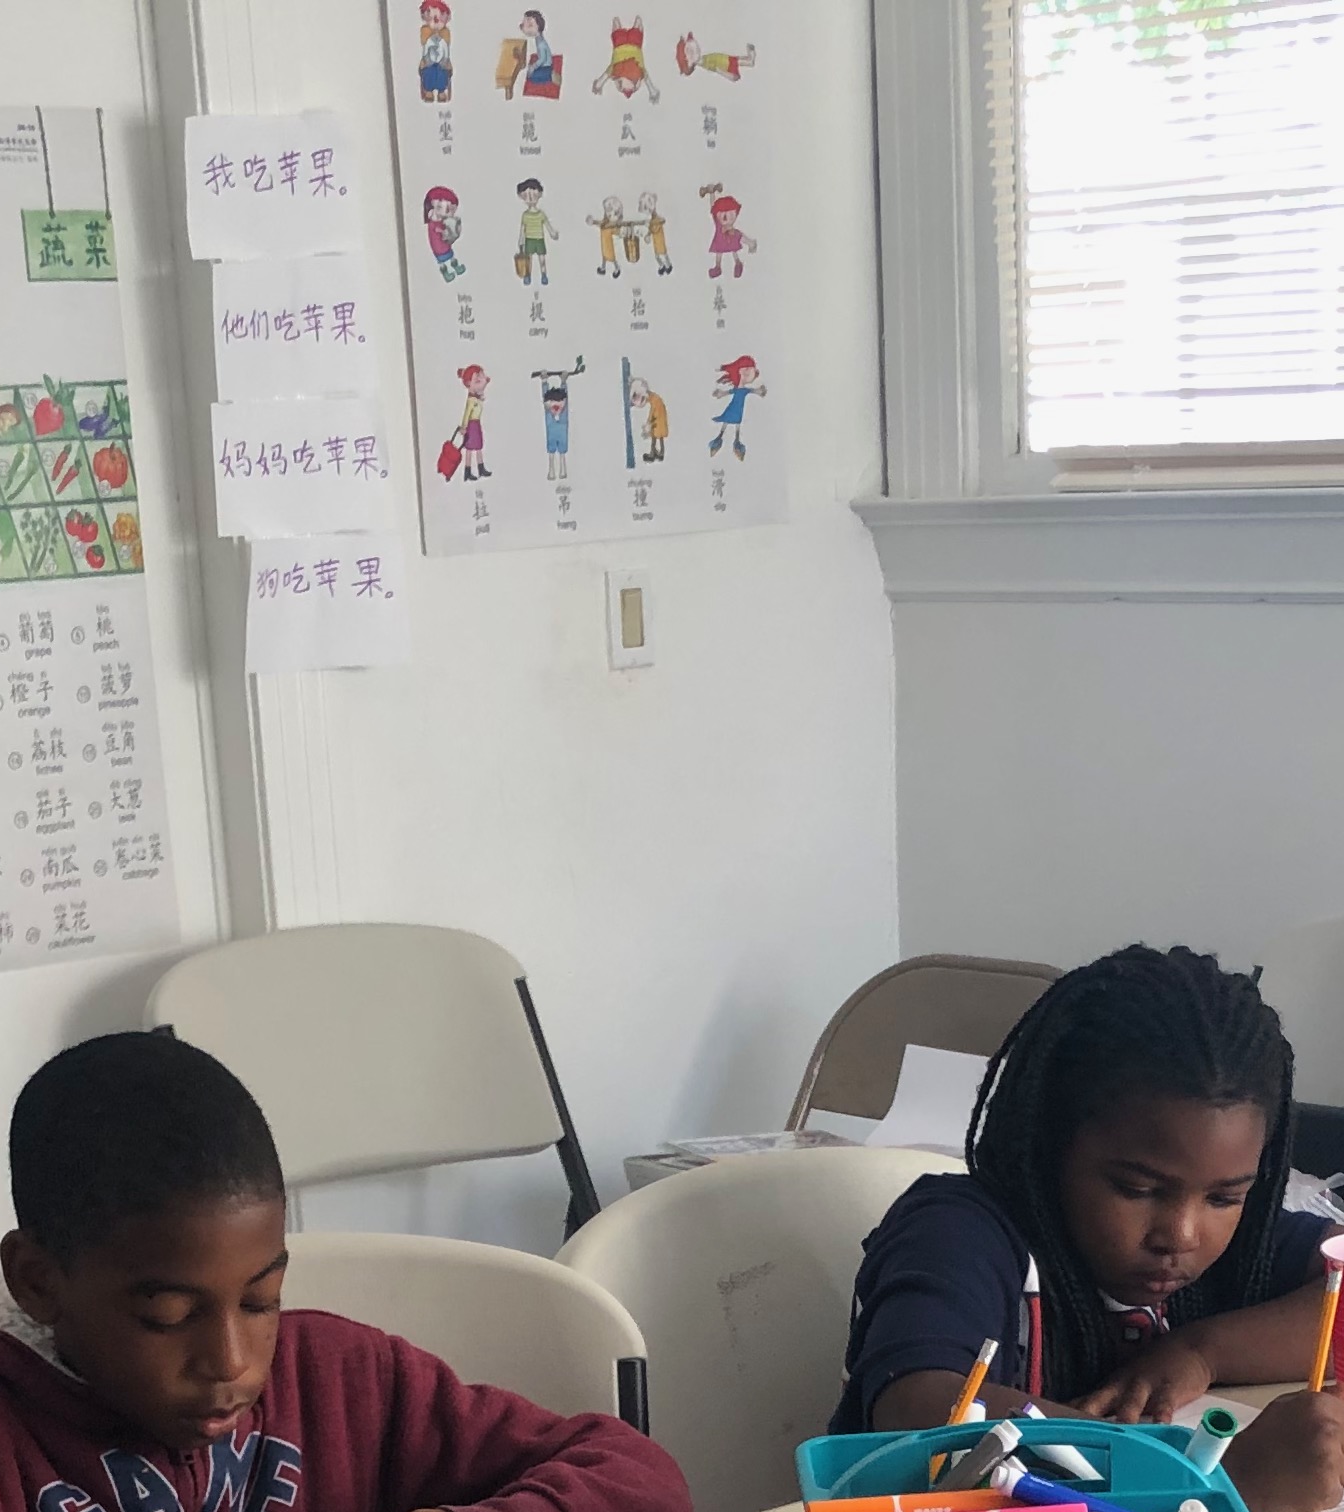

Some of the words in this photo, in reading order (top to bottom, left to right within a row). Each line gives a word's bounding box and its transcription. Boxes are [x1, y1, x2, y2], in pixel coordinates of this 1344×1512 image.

[203, 147, 347, 198] 我吃苹果。
[38, 220, 111, 269] 蔬菜
[221, 301, 366, 346] 他们吃苹果。
[219, 435, 388, 481] 妈妈吃苹果。
